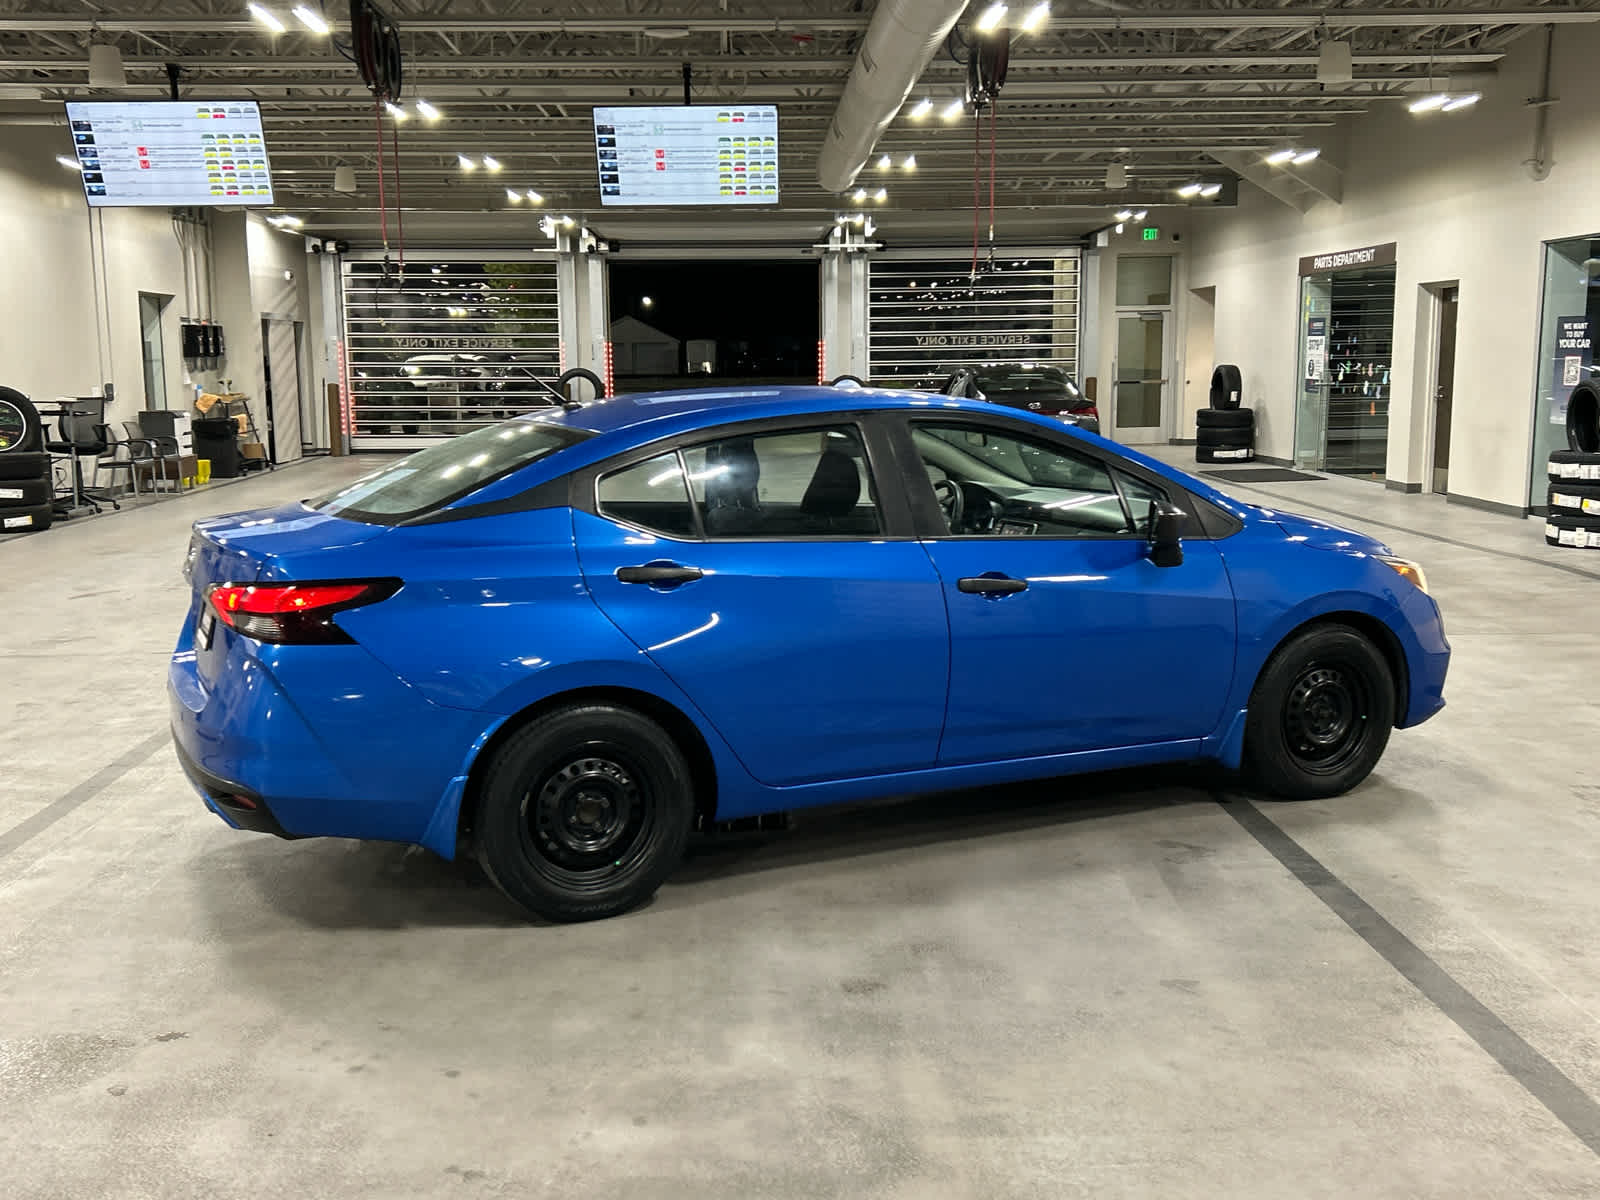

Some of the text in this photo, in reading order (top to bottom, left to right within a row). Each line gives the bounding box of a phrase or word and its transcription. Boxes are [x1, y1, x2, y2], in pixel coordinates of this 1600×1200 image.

[1143, 228, 1157, 240] EXIT
[1313, 248, 1375, 269] PARTS DEPARTMENT
[1563, 322, 1588, 330] WE WANT
[1559, 339, 1591, 348] YOUR CAR
